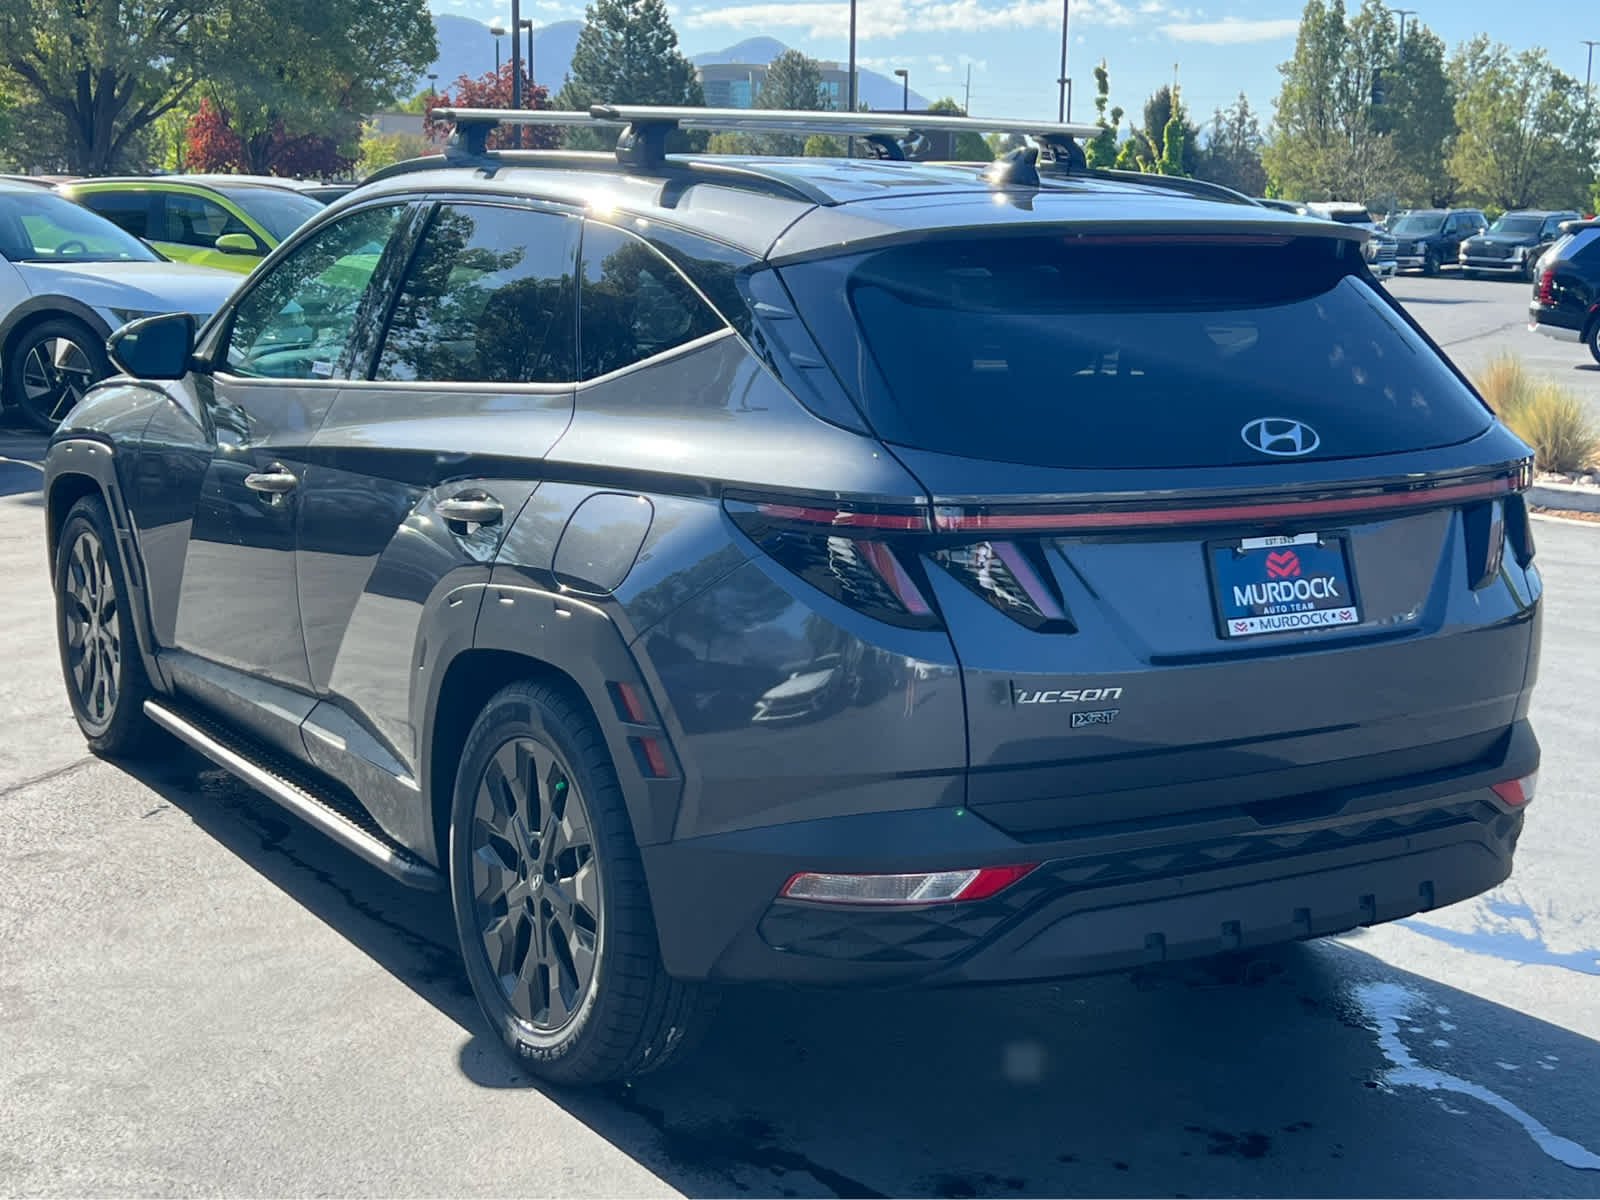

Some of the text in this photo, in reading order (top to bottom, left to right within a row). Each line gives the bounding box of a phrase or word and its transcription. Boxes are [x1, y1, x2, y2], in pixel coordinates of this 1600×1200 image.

[1233, 576, 1339, 607] MURDOCK
[1263, 602, 1315, 615] AUTO TEAM
[1259, 611, 1329, 630] MURDOCK
